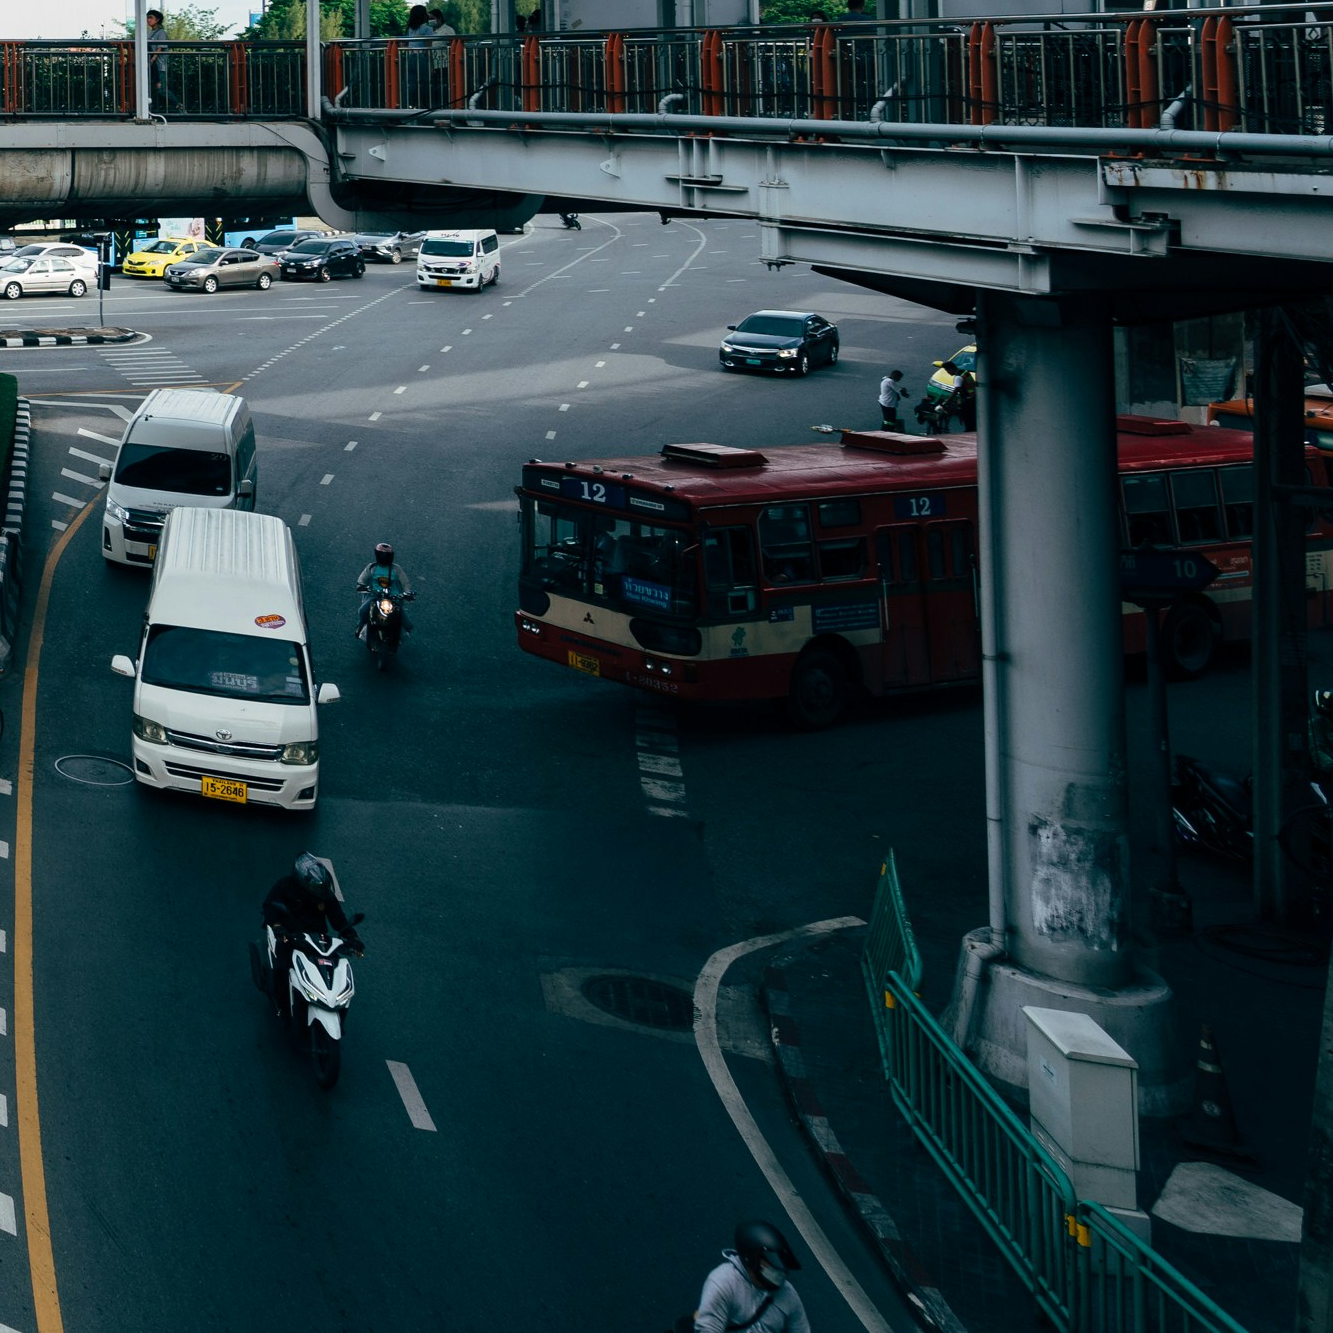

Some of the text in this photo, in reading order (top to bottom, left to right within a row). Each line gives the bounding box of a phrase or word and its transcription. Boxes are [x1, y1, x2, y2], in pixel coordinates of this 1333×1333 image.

[580, 481, 607, 503] 12
[909, 497, 932, 517] 12
[1172, 559, 1197, 579] 10
[623, 577, 669, 600] ห้วยขวาง
[642, 593, 667, 608] Khwang
[625, 671, 679, 693] 1-80352
[205, 781, 244, 798] 15-2646
